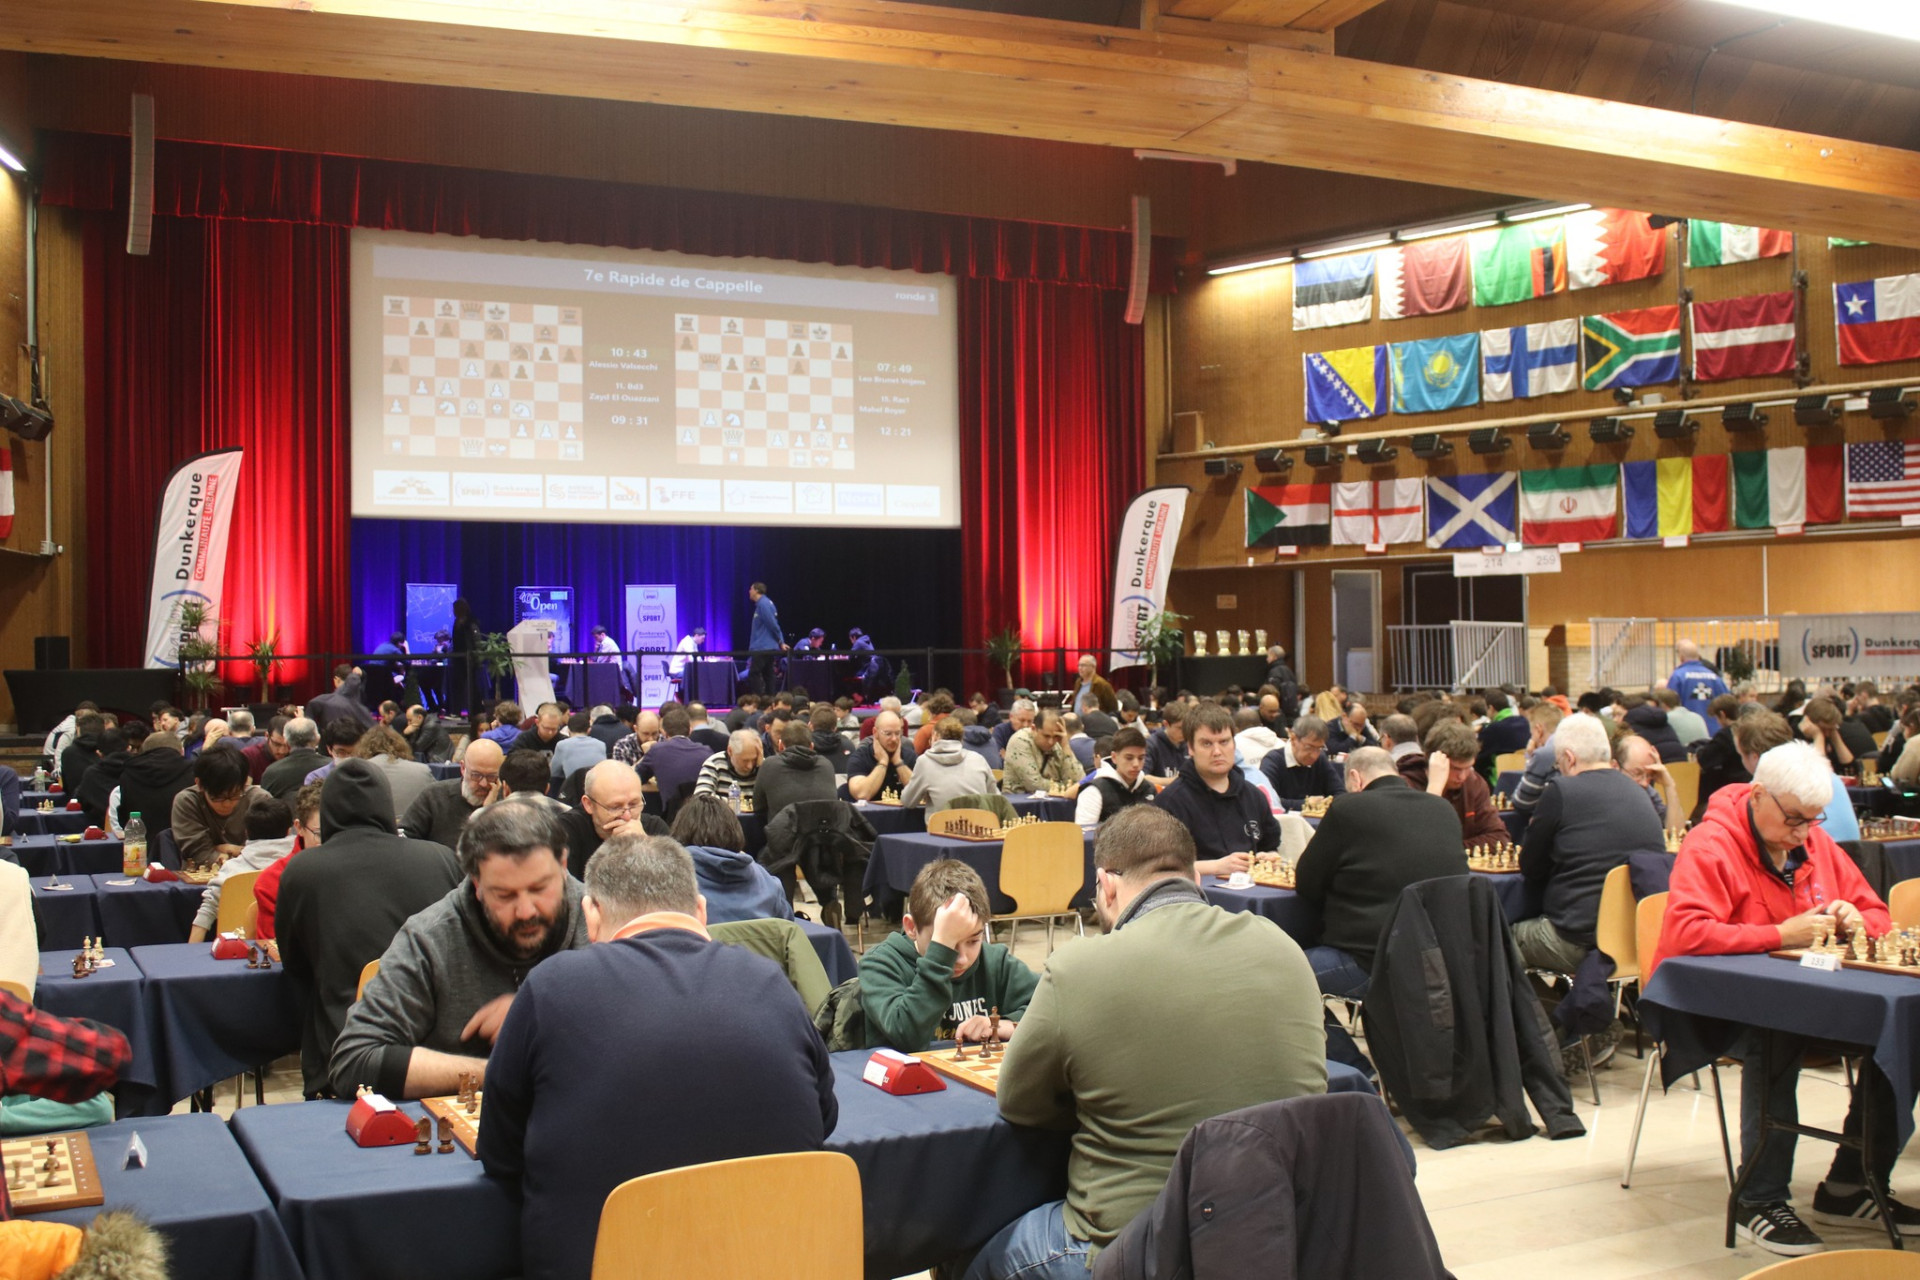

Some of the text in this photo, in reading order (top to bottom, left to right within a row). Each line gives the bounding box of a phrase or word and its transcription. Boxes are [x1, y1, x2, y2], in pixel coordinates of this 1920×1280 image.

[584, 269, 763, 294] 7e Rapide de Cappelle
[895, 291, 926, 301] ronde
[611, 347, 624, 357] 10
[633, 349, 647, 359] 43
[877, 363, 890, 372] 07
[611, 415, 626, 425] 09
[636, 416, 648, 426] 31
[880, 426, 891, 436] 12
[900, 427, 911, 437] 21
[205, 475, 219, 513] URBAINE
[672, 490, 696, 500] FFE
[176, 472, 203, 581] Dunkerque
[1131, 500, 1157, 588] Dunkerque
[1484, 557, 1504, 569] 214
[1536, 554, 1556, 566] 259
[530, 595, 558, 614] Open
[1811, 644, 1851, 658] SPORT
